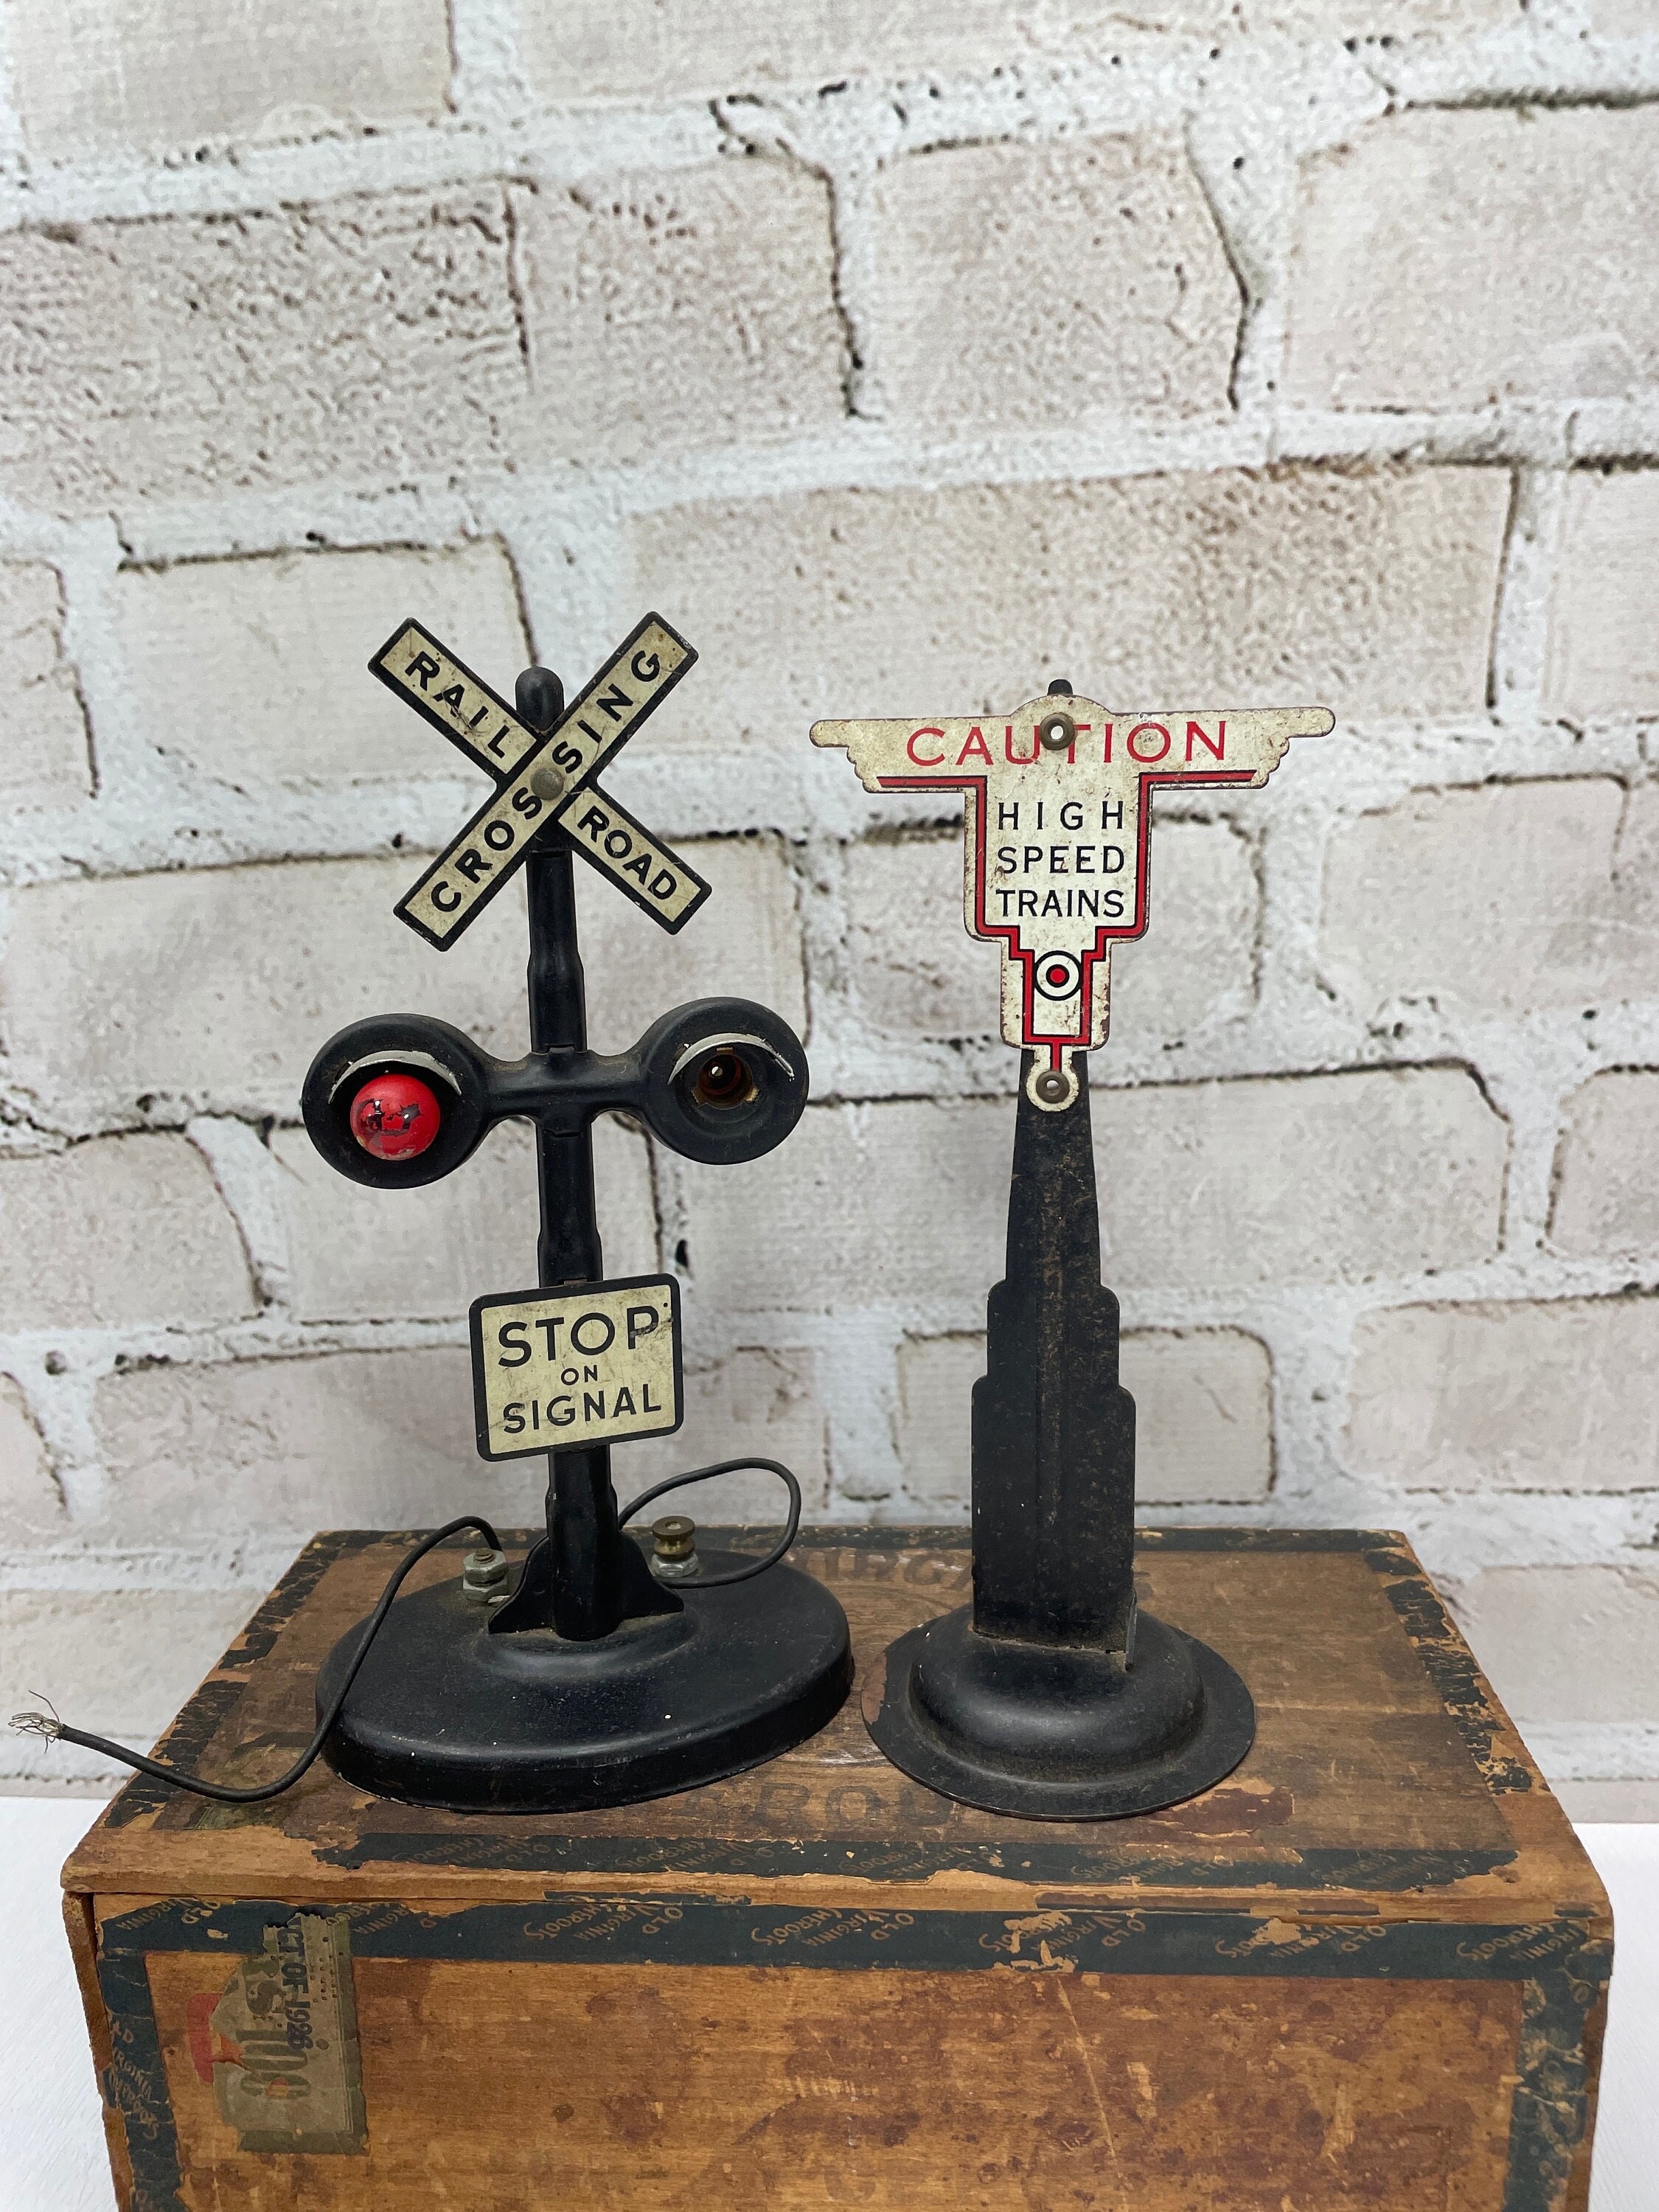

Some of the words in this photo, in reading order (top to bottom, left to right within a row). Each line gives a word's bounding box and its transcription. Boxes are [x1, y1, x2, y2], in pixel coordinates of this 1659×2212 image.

[906, 720, 1227, 767] CAUTION
[405, 651, 509, 758] RAIL
[577, 805, 677, 901] ROAD
[431, 650, 661, 913] CROSSING
[998, 801, 1124, 830] HIGH
[998, 845, 1125, 874] SPEED
[996, 889, 1124, 918] TRAINS
[498, 1305, 659, 1368] STOP
[560, 1364, 598, 1385] ON
[503, 1383, 662, 1434] SIGNAL
[641, 1906, 684, 1934] OLD
[801, 1910, 891, 1947] VIRGINIA
[870, 1912, 915, 1941] OLD
[1101, 1918, 1147, 1948] OLD
[1340, 1924, 1387, 1952] OLD
